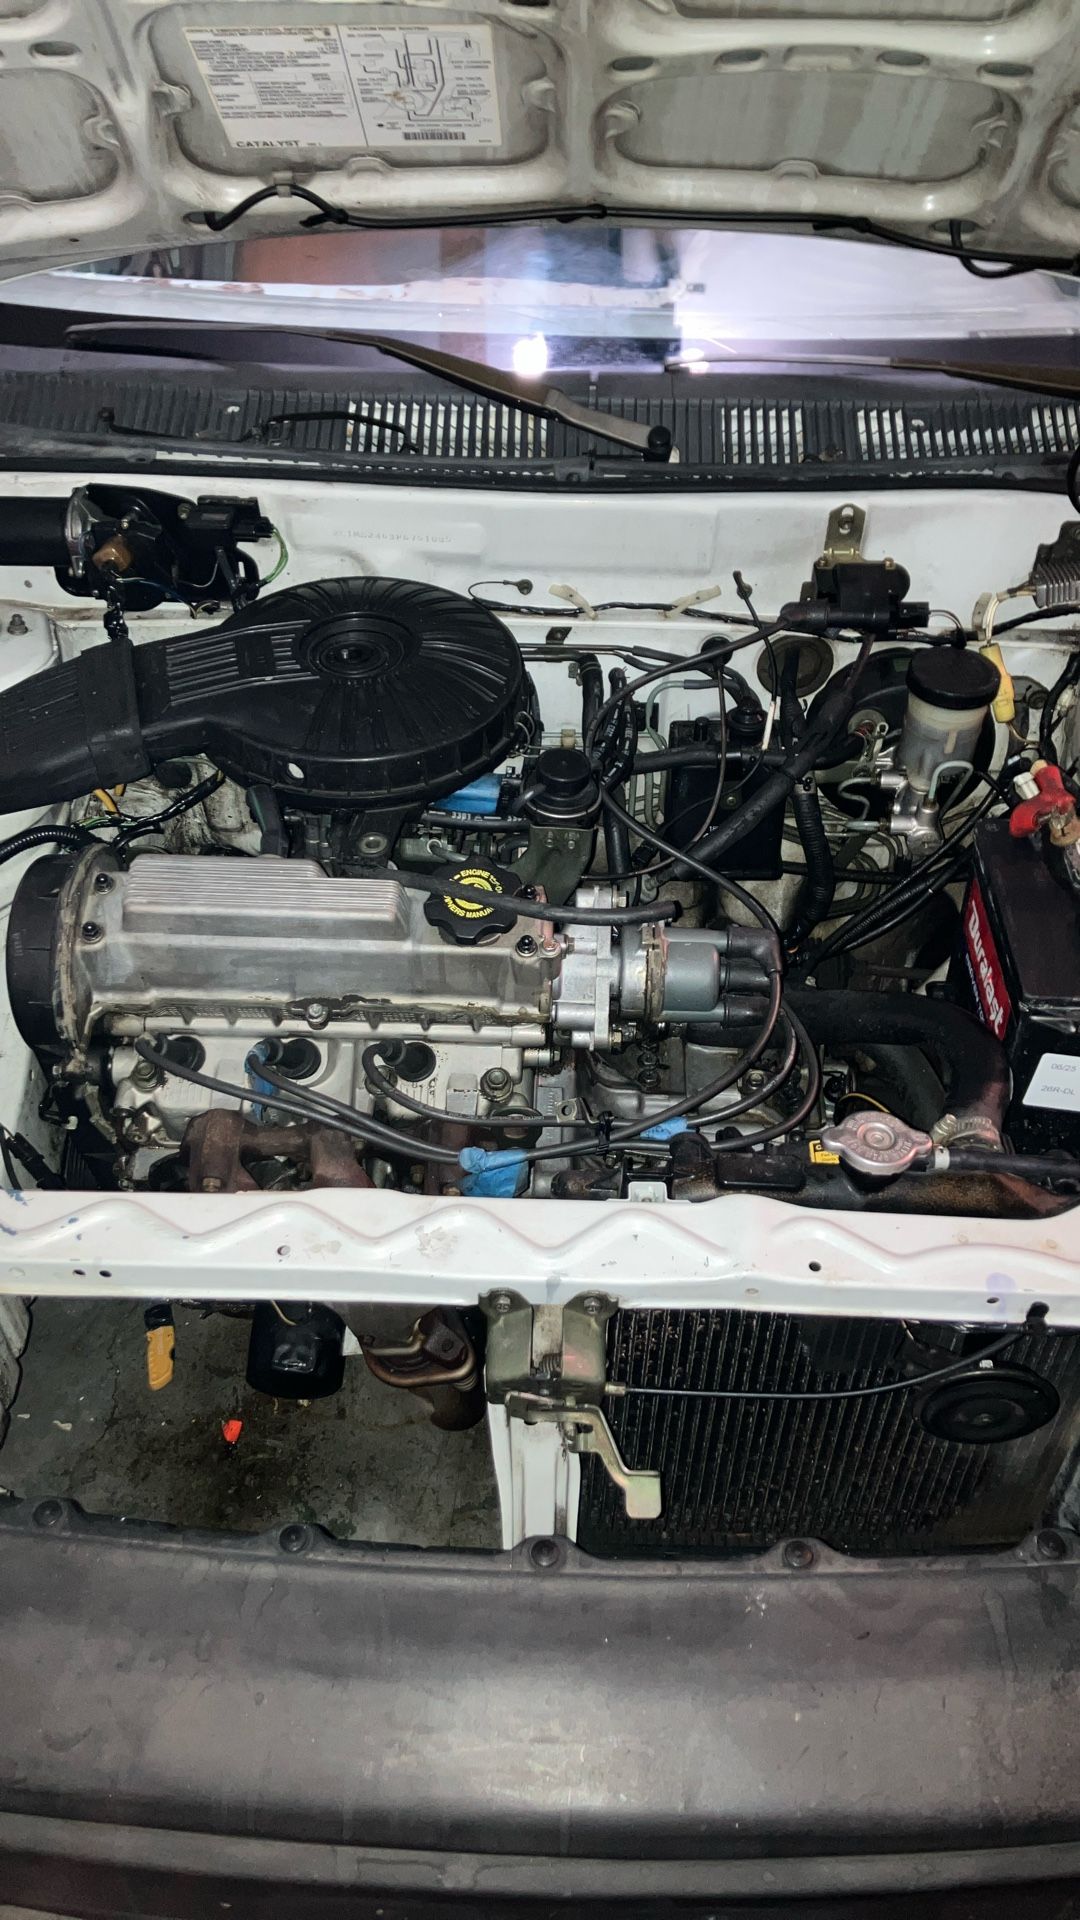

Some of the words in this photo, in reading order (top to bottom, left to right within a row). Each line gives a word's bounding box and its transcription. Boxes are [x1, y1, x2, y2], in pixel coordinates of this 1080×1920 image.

[460, 868, 491, 879] ENGINE
[465, 907, 495, 918] MANUA
[968, 899, 1004, 1036] Duralast
